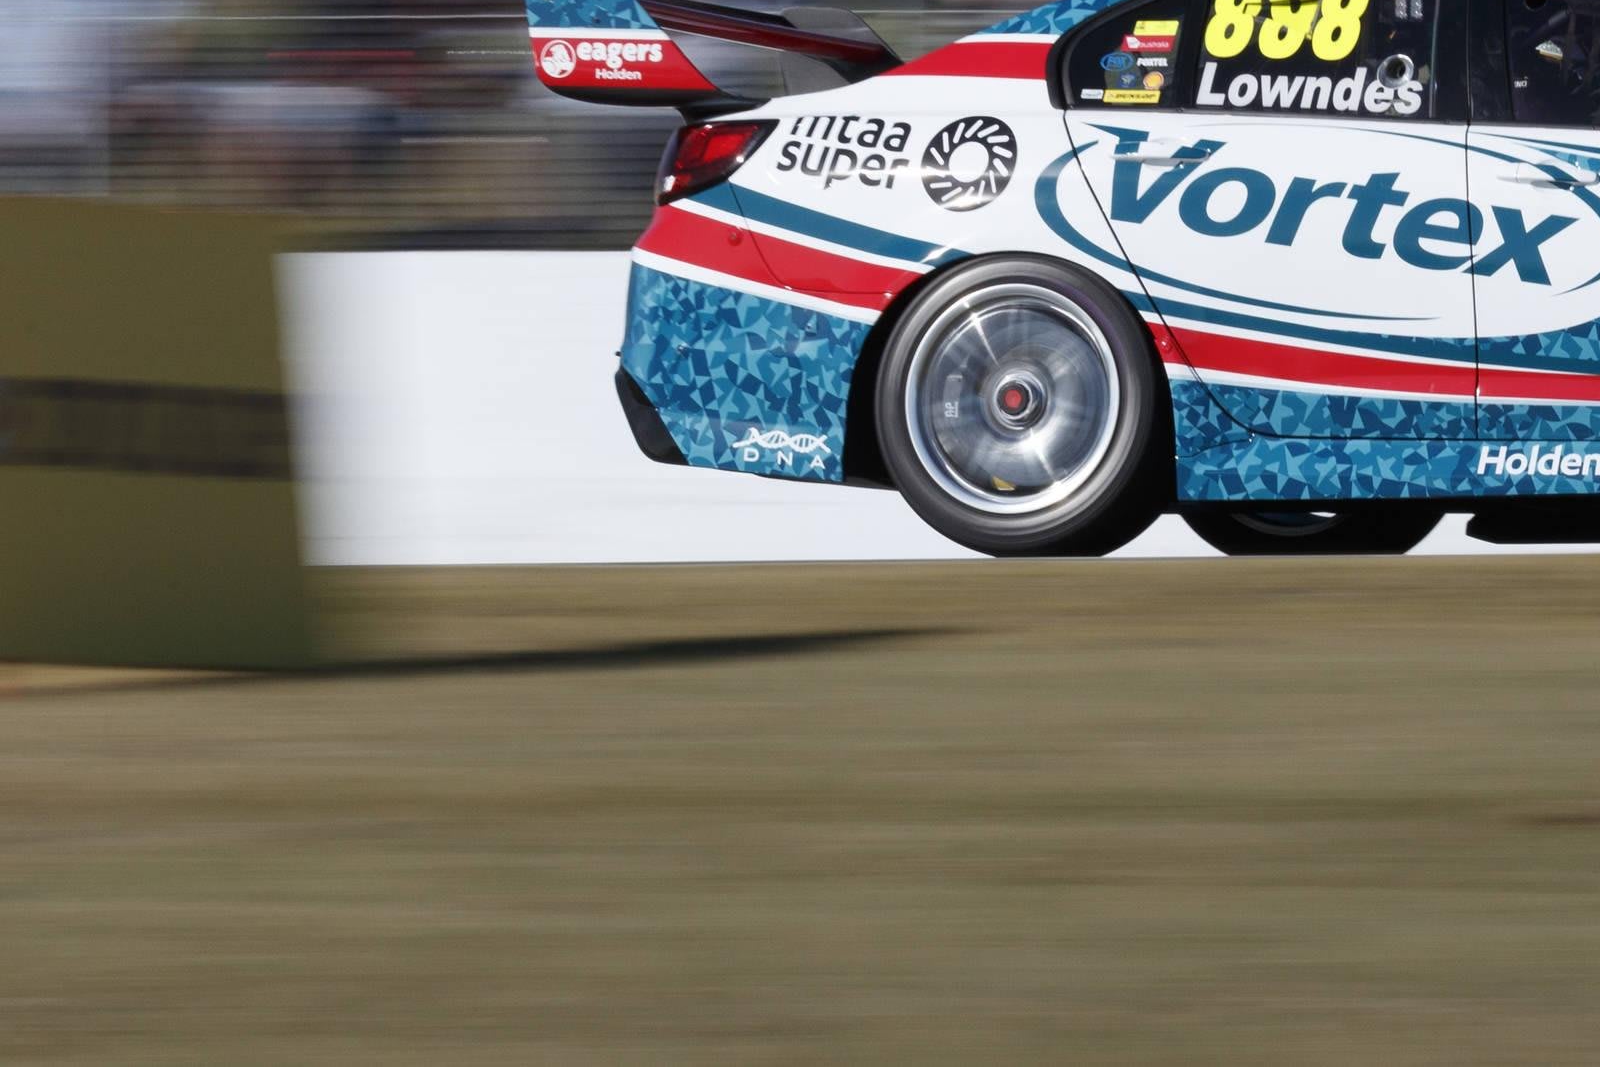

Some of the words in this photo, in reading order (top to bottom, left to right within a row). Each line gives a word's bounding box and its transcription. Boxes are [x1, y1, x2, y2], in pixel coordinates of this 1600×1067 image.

[576, 41, 663, 70] eagers
[595, 68, 642, 81] Holden
[1196, 61, 1424, 115] Lowndes
[790, 115, 912, 152] mtaa
[776, 140, 910, 190] super
[1083, 122, 1581, 287] Vortex
[743, 447, 826, 469] DNA
